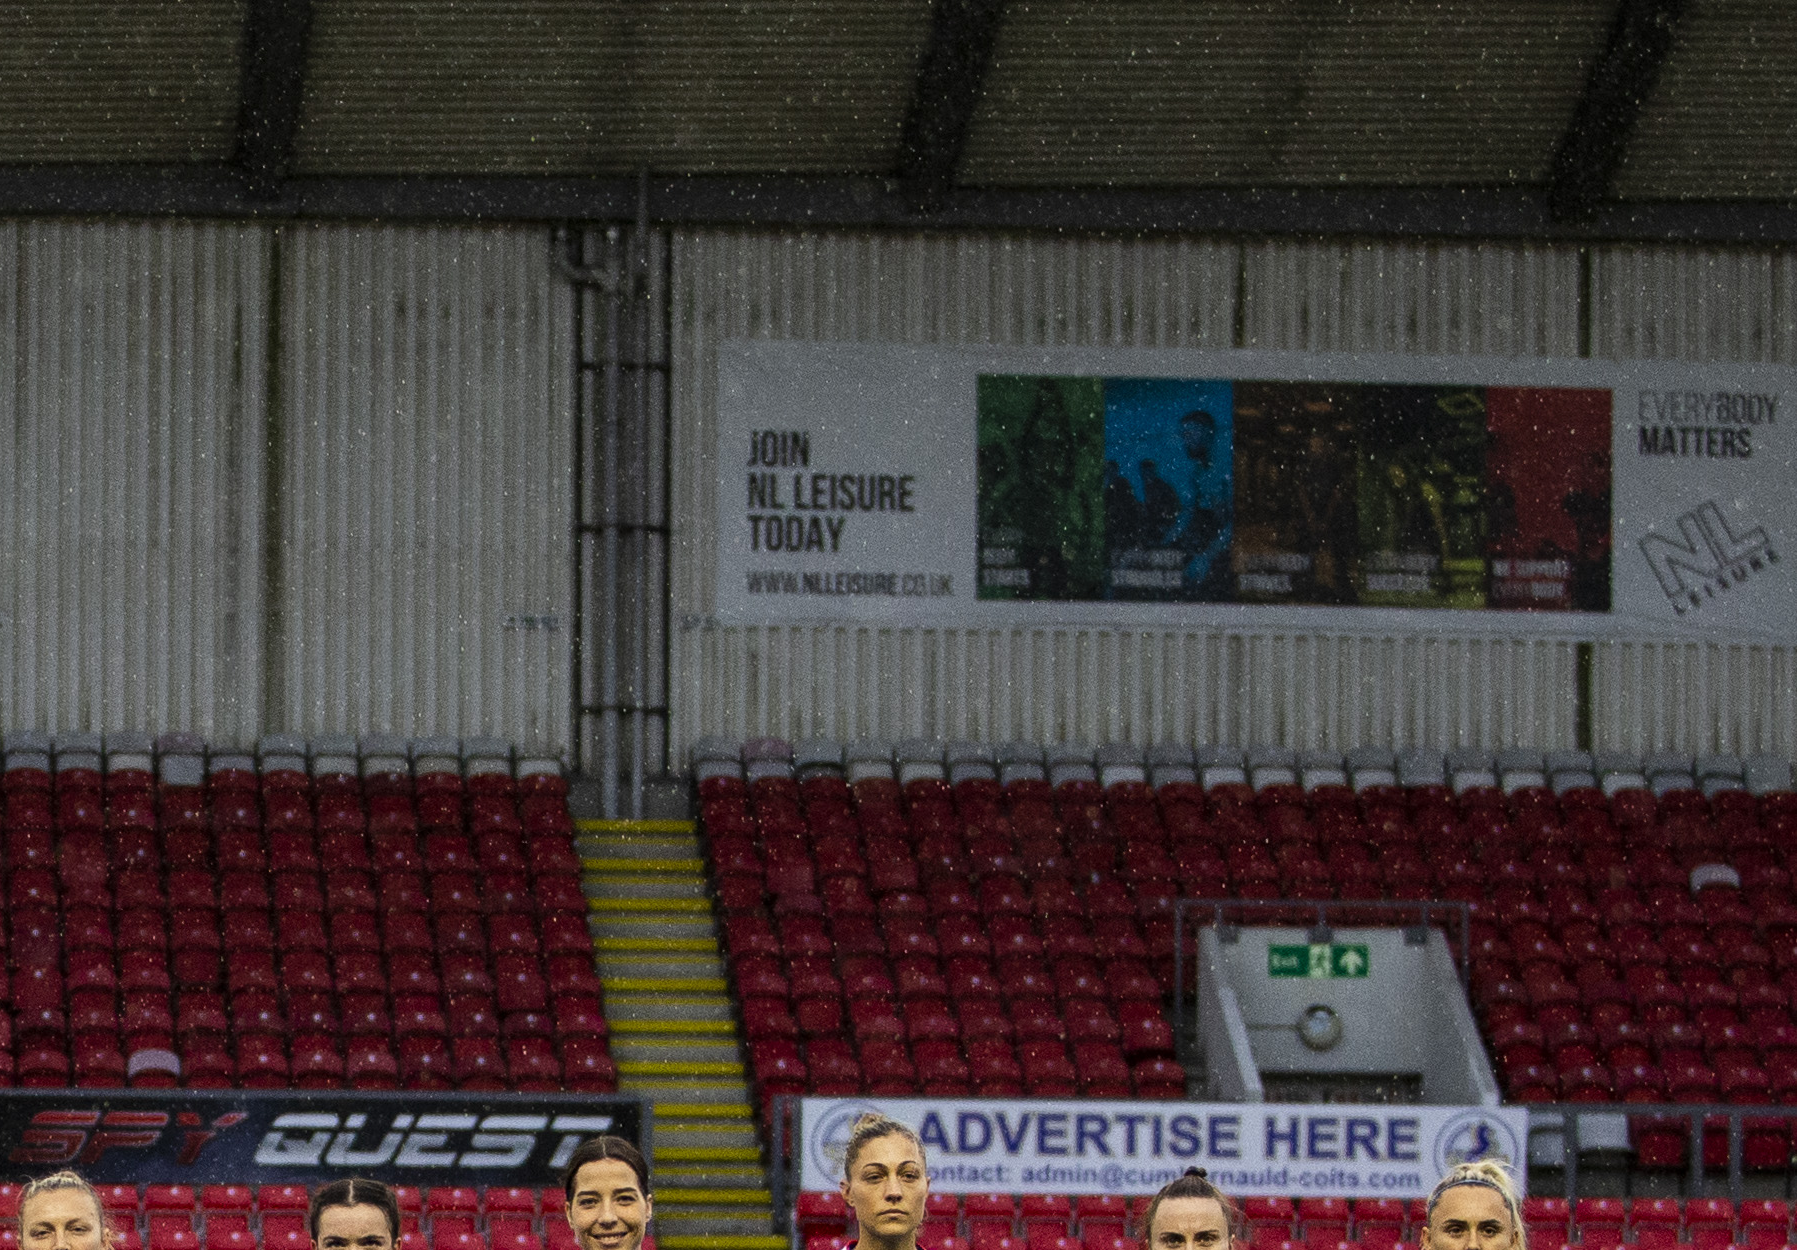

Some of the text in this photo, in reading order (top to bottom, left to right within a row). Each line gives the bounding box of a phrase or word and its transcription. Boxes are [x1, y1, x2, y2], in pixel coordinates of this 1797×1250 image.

[1638, 389, 1779, 424] EVERYBODY
[747, 430, 810, 467] JOIN
[1638, 426, 1753, 458] MATTERS
[748, 473, 915, 512] NL LEISURE
[748, 515, 845, 552] TODAY
[918, 1111, 1422, 1161] ADVERTISE HERE
